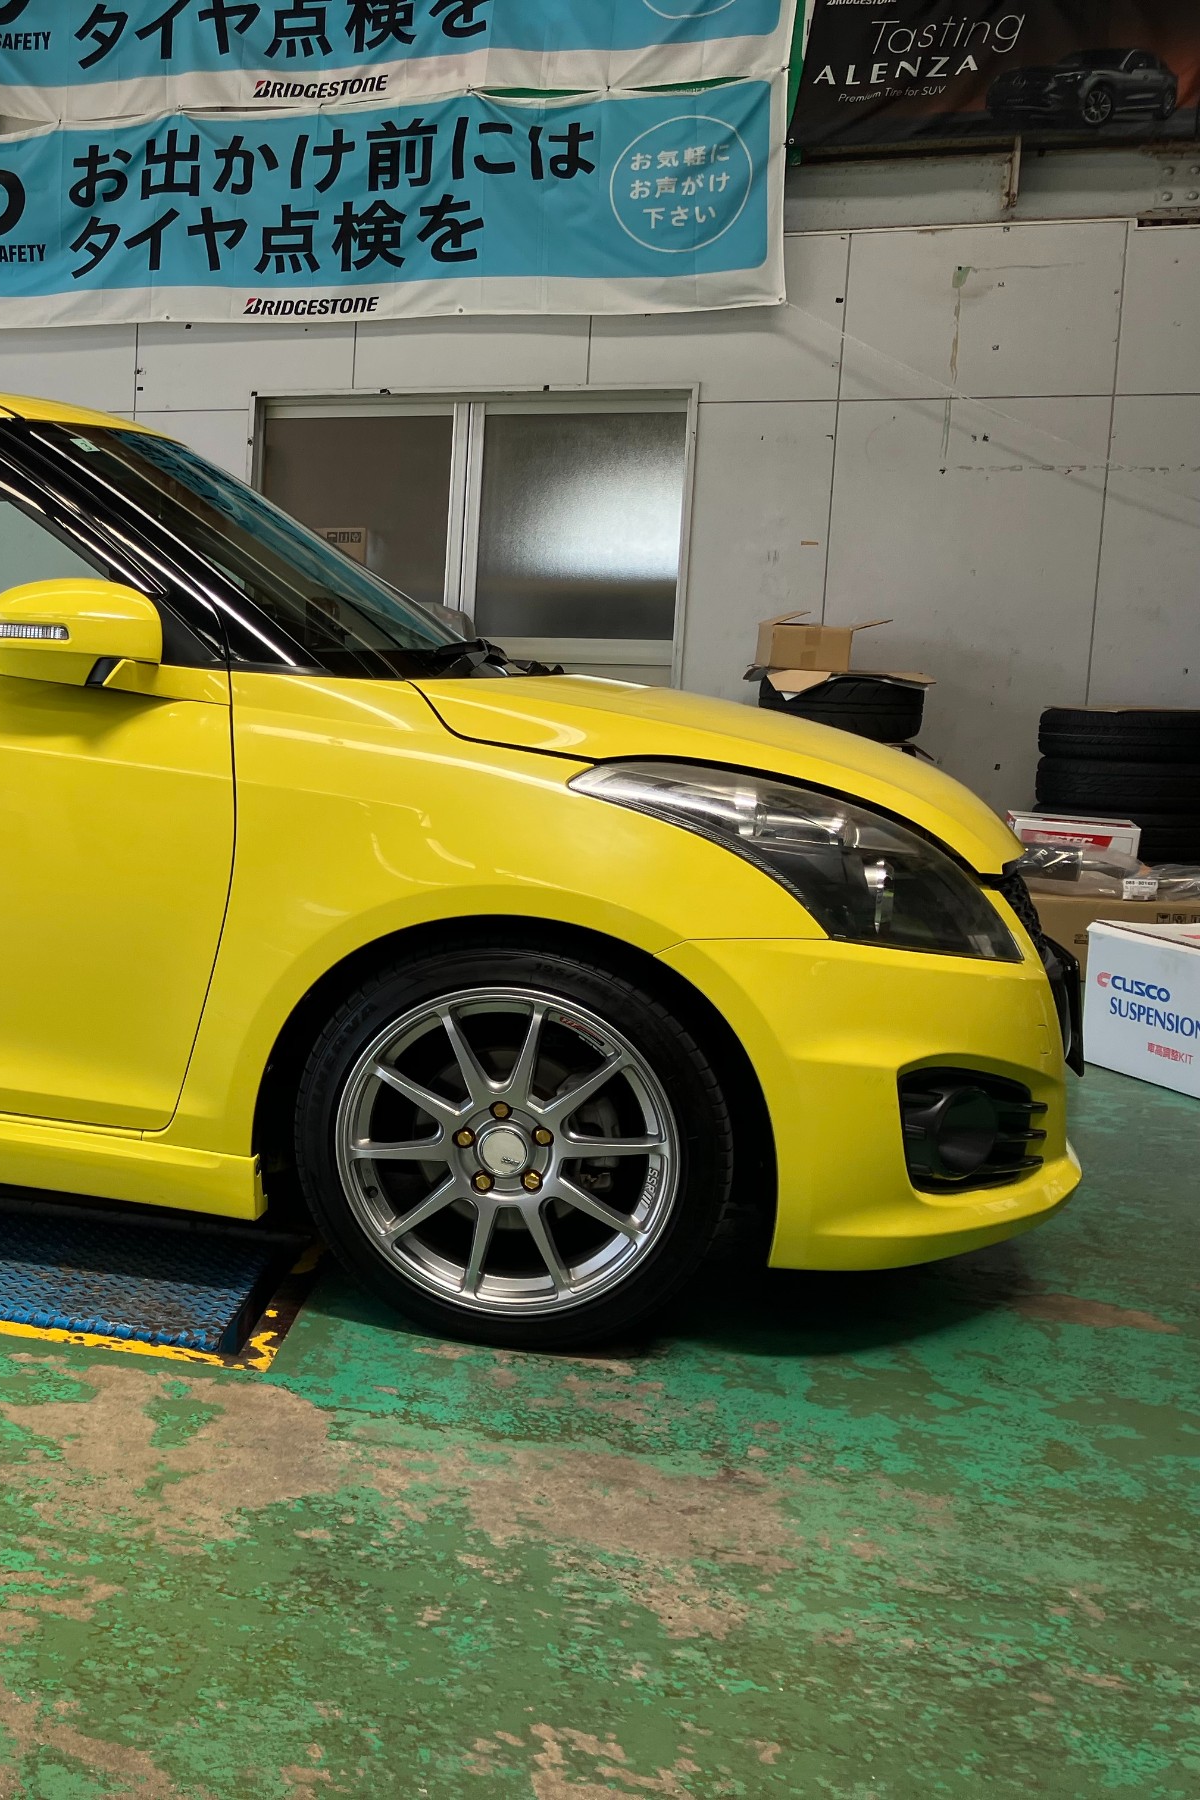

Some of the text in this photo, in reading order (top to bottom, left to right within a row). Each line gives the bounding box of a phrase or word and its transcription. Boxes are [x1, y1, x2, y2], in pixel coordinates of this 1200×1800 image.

[74, 0, 487, 70] タイヤ点検を
[871, 14, 1026, 54] Tasting
[813, 55, 979, 85] ALENZA
[252, 74, 389, 99] BRIDGESTONE
[838, 85, 947, 102] Premium Tire for SUV
[69, 115, 596, 208] お出かけ前には
[630, 144, 730, 171] お気軽に
[629, 172, 730, 199] お声がけ
[643, 206, 716, 229] 下さい
[69, 194, 485, 279] タイヤ点検を
[243, 296, 379, 316] BRIDGESTONE
[1111, 975, 1171, 1002] CUSCO
